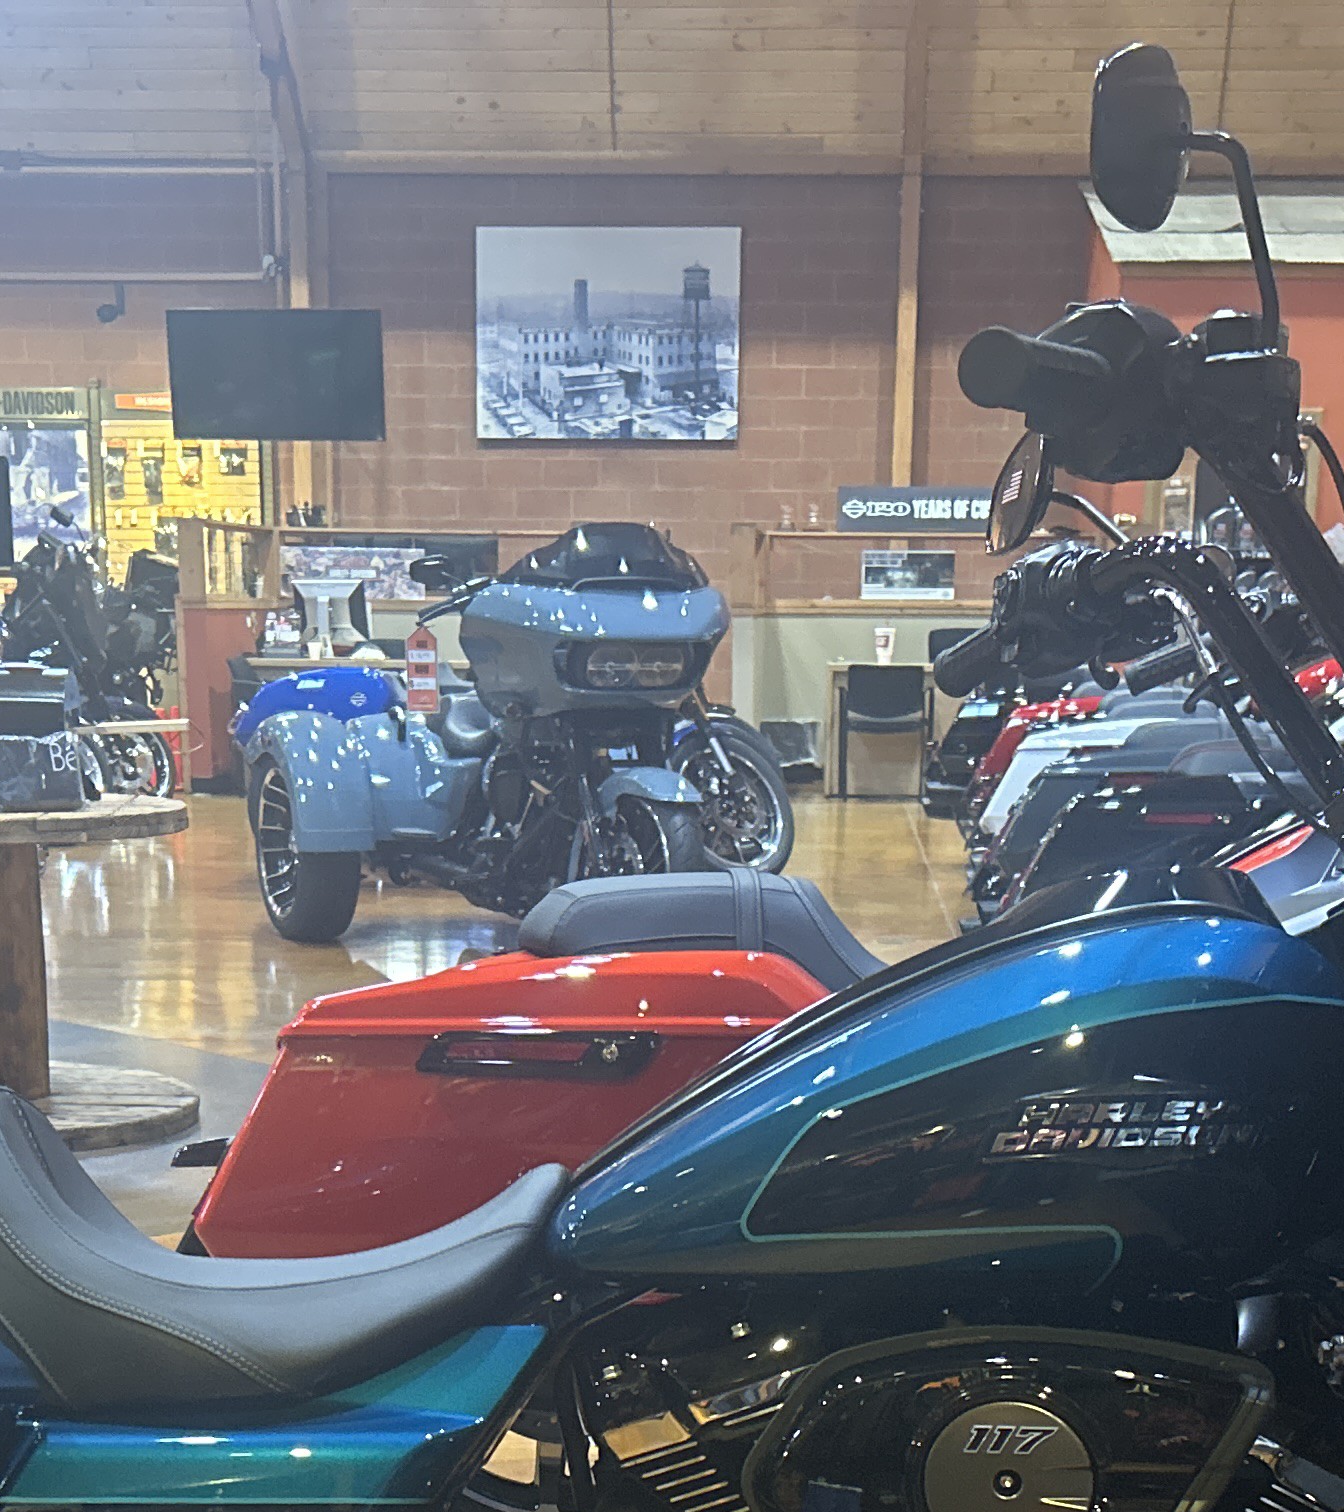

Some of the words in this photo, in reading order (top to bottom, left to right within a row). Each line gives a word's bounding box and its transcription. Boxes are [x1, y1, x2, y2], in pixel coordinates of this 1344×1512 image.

[912, 499, 952, 519] YEARS
[953, 499, 969, 519] OF
[1018, 1100, 1224, 1127] HARLEY
[963, 1424, 1059, 1455] 117
